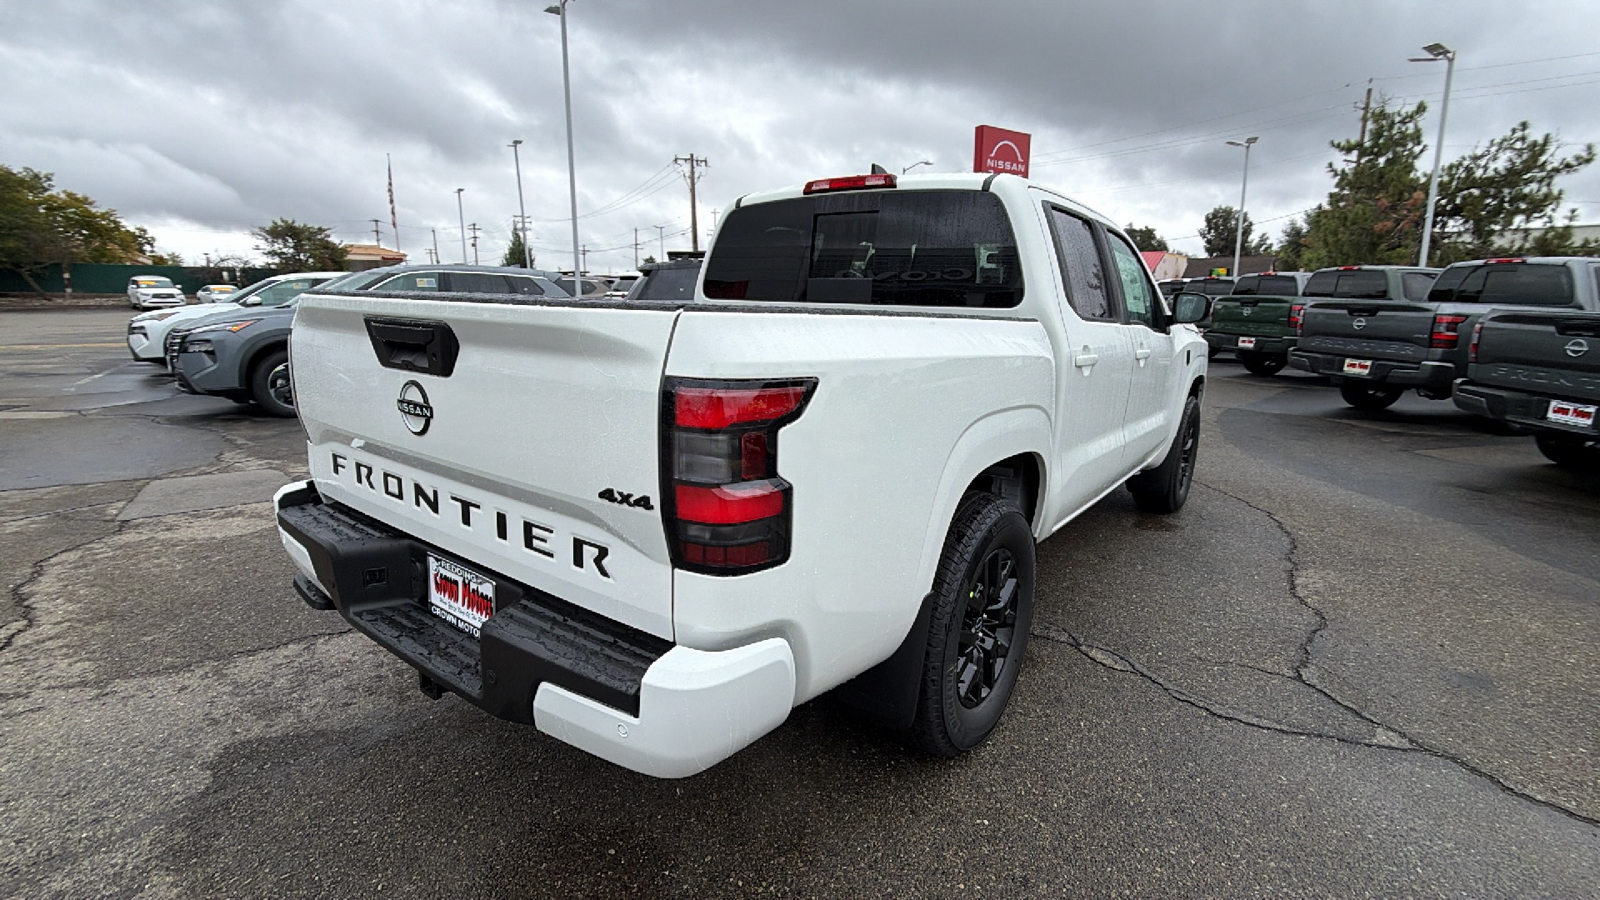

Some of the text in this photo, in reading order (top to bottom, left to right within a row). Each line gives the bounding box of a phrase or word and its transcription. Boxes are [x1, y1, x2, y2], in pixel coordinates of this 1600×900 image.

[987, 158, 1025, 172] NISSAN
[397, 400, 431, 417] NISSAN
[597, 487, 654, 511] 4x4
[331, 452, 612, 579] FRONTIER
[441, 560, 477, 582] REDDING
[433, 572, 459, 604] Crown
[461, 579, 492, 619] Motors
[431, 605, 457, 626] CROWN
[457, 619, 480, 638] MOTO
